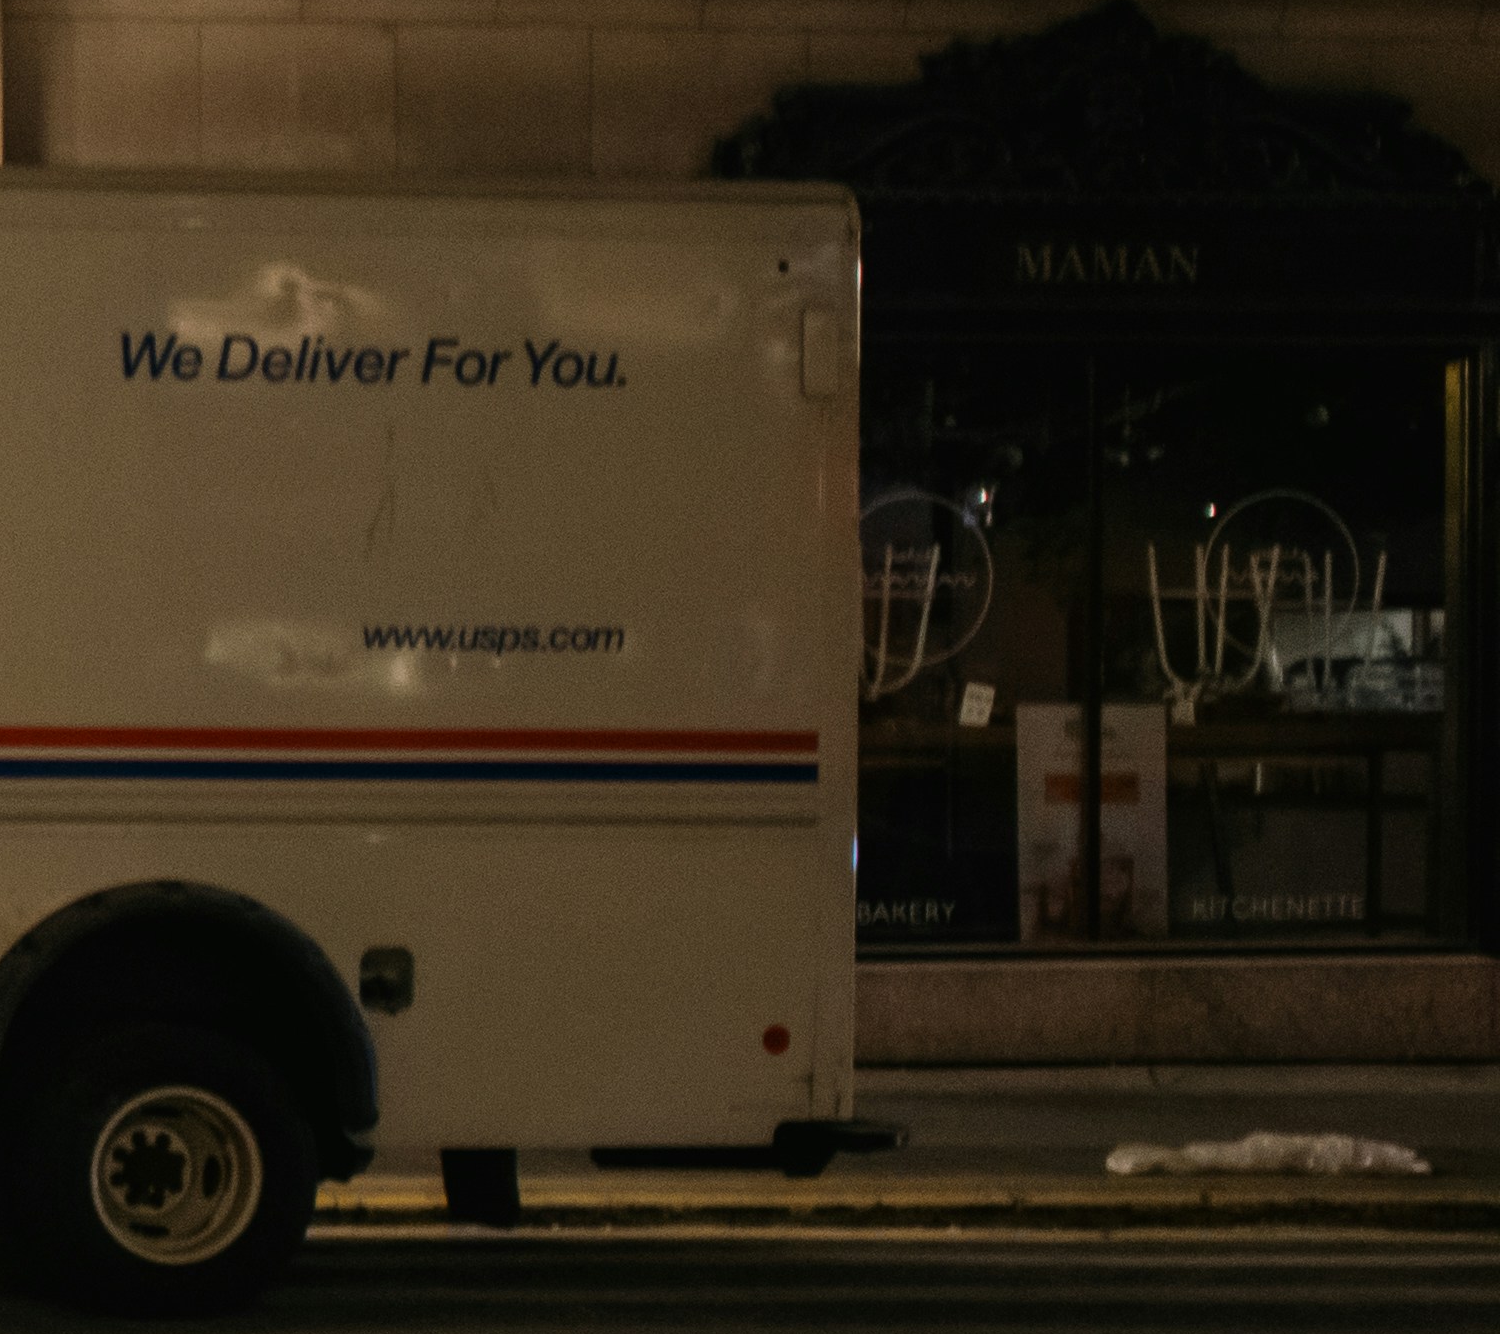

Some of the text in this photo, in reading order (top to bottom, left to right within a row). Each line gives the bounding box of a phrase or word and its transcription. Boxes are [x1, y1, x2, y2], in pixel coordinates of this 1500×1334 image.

[1014, 242, 1199, 284] MAMAN
[120, 331, 628, 388] We Deliver For You.
[362, 624, 626, 657] www.usps.com
[857, 898, 956, 926] BAKERY
[1191, 893, 1365, 922] KITCHENETTE
